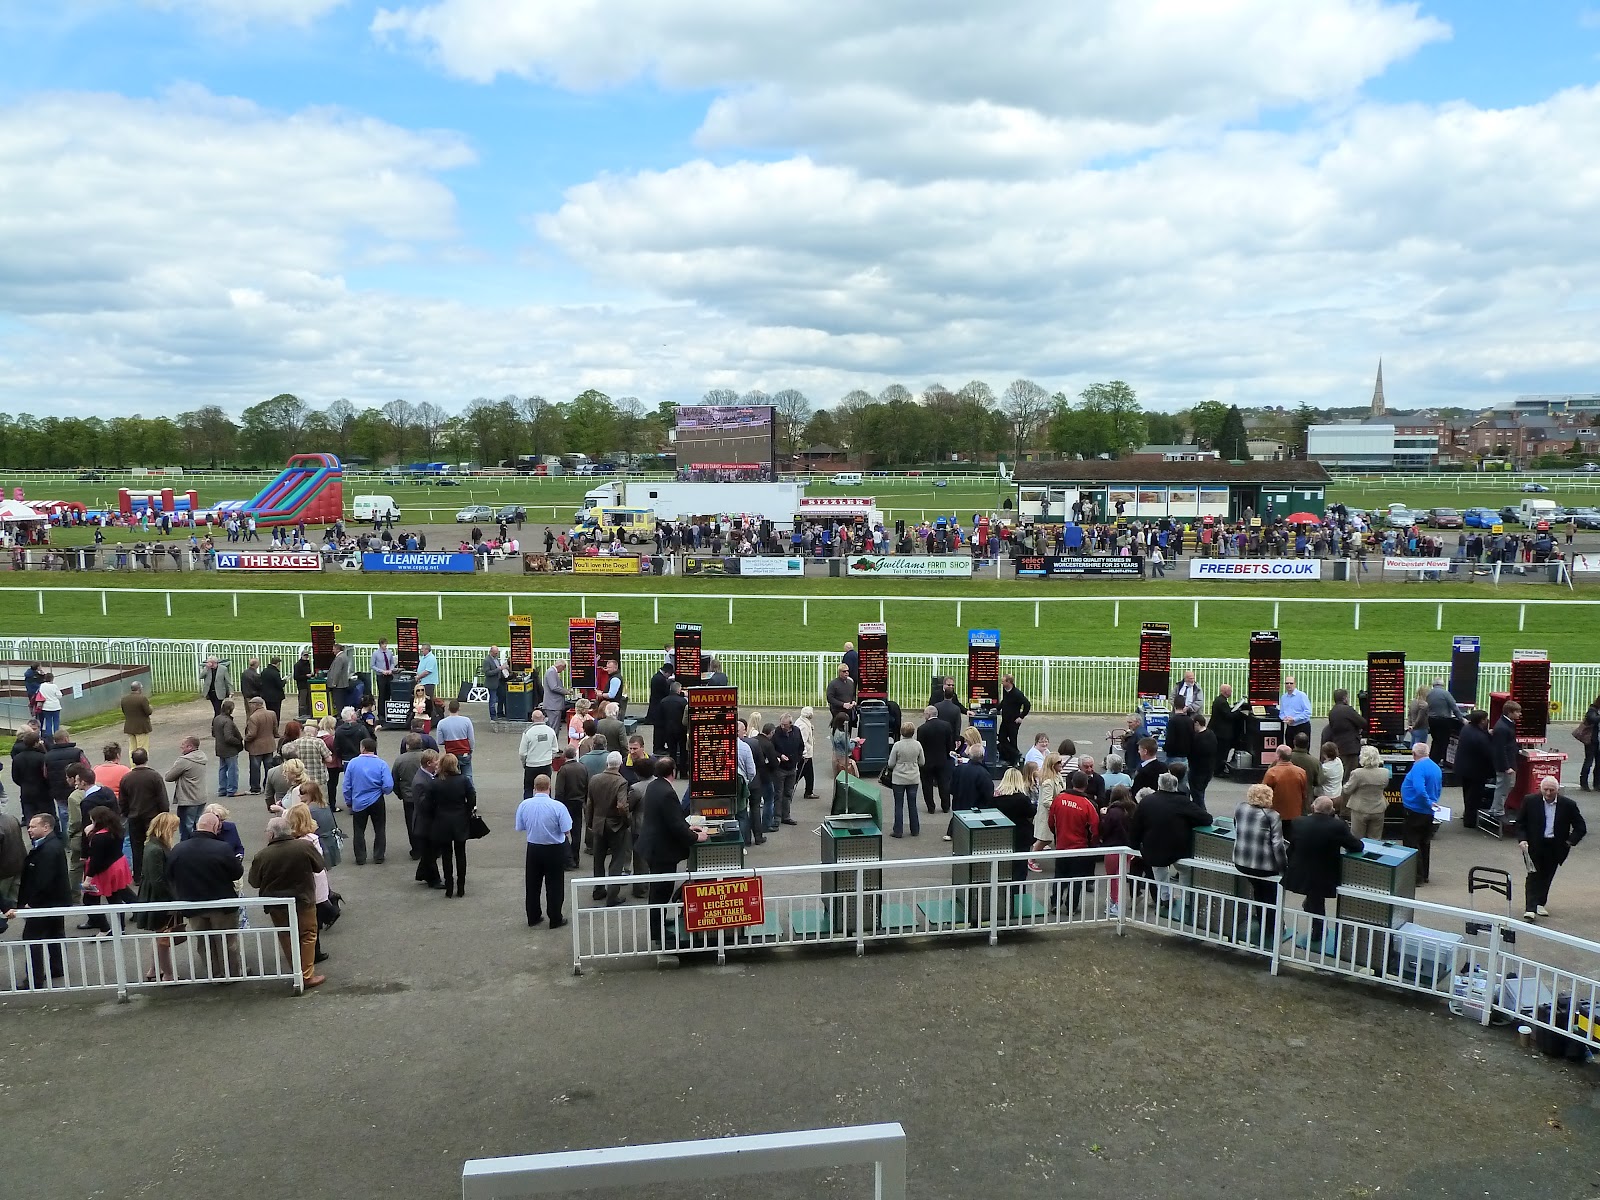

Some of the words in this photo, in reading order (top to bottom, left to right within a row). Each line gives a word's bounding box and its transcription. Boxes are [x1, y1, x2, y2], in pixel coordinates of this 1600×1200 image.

[220, 555, 238, 567] AT
[241, 555, 270, 567] THE
[271, 555, 317, 567] RACES
[383, 554, 452, 565] CLEANEVENT
[876, 557, 925, 572] Gwillams
[1199, 564, 1313, 574] FREEBETS.CO.UK
[691, 694, 735, 703] MARTYN
[1265, 738, 1276, 746] 18
[1061, 799, 1078, 809] WBR
[696, 882, 749, 897] MARTYN
[703, 898, 744, 910] LEICESTER
[704, 909, 722, 918] CASH
[723, 907, 745, 916] TAKEN
[697, 918, 719, 926] EURO,
[721, 914, 752, 924] DOLLARS
